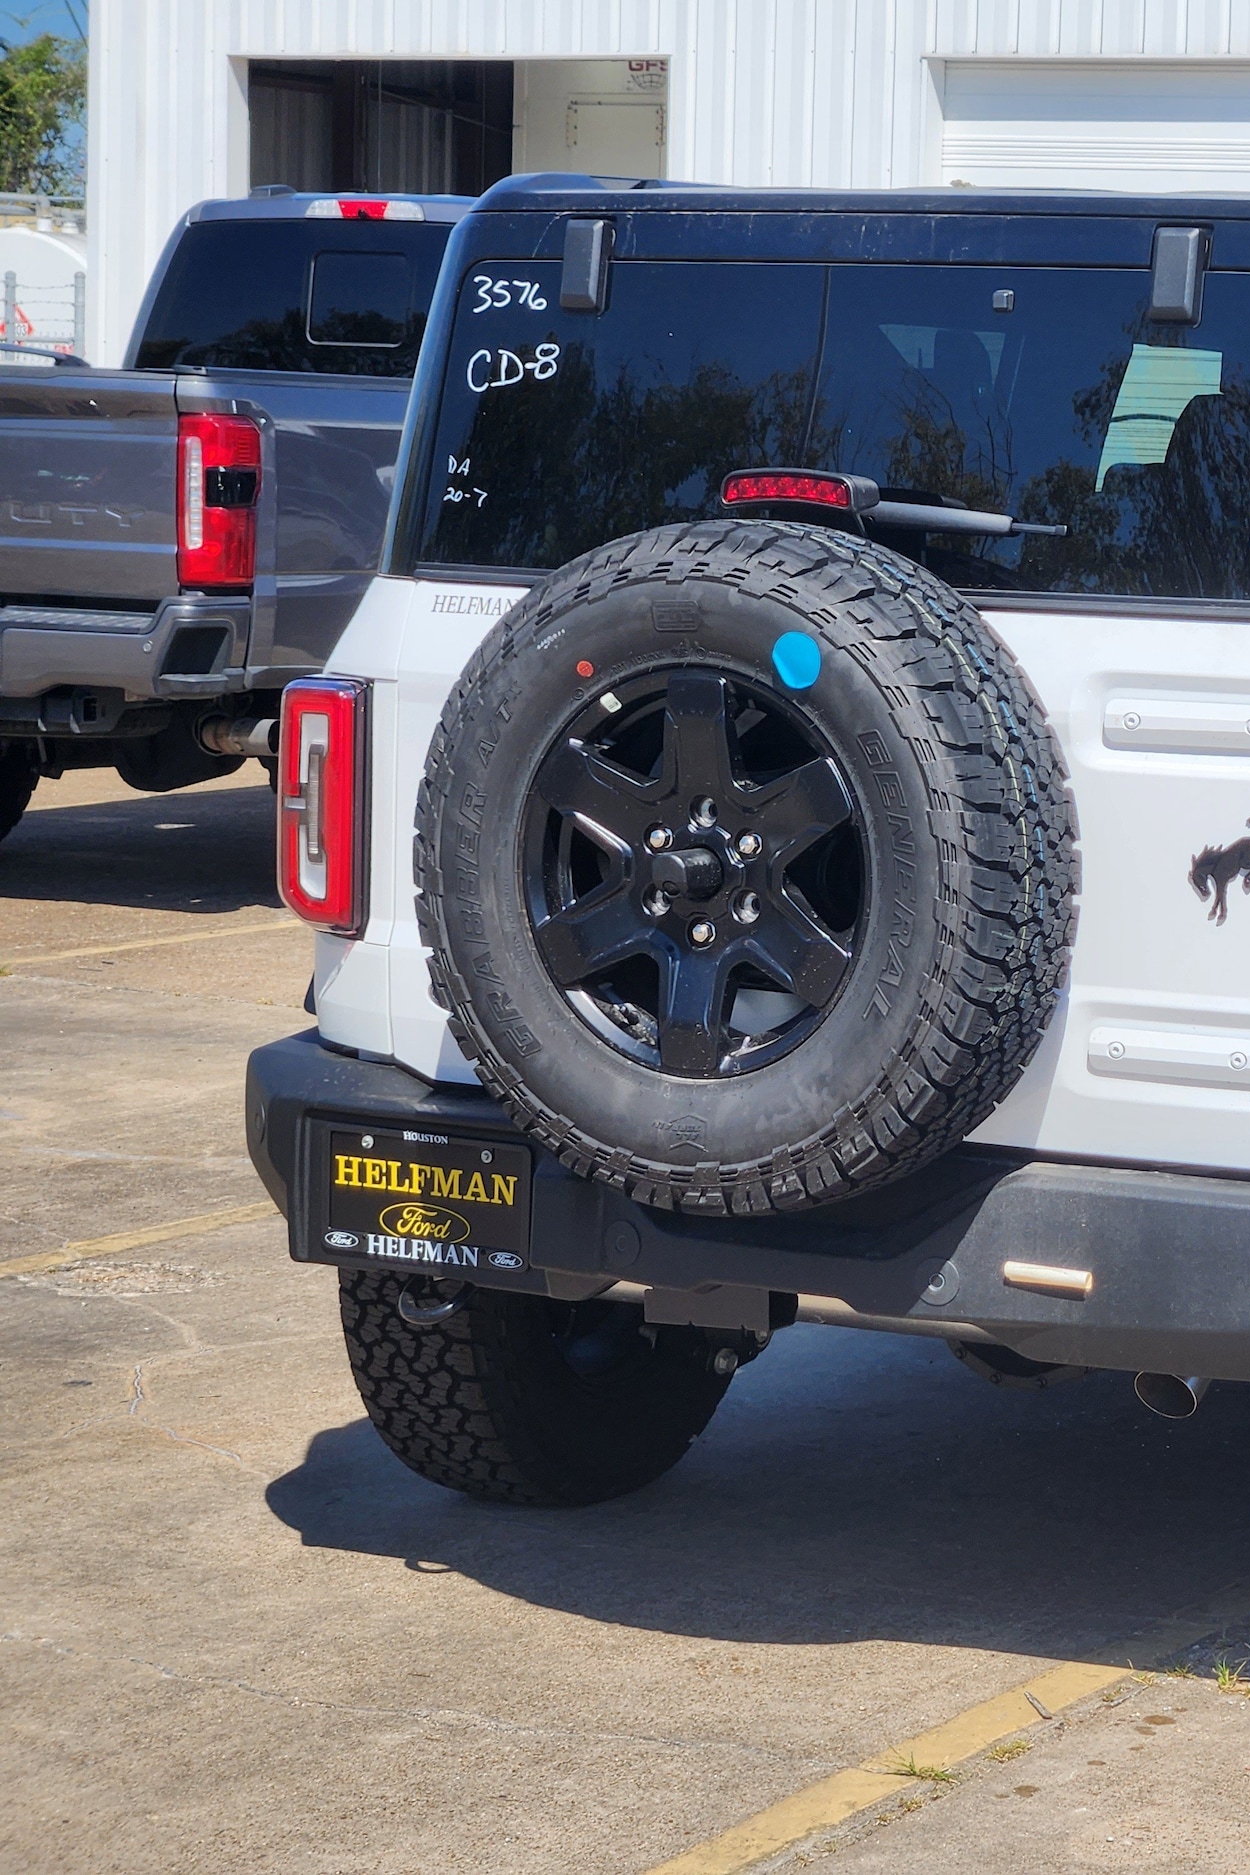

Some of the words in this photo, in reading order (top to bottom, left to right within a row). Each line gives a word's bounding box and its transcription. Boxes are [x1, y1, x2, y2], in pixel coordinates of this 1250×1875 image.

[473, 275, 548, 313] 3576
[467, 342, 560, 392] CD-8
[443, 487, 489, 507] 20-7
[856, 728, 917, 1020] GENERAL
[455, 781, 543, 1058] GRABBER
[402, 1130, 449, 1145] HOUSTON
[334, 1154, 518, 1206] HELFMAN
[396, 1205, 451, 1239] Ford
[366, 1233, 480, 1268] HELFMAN
